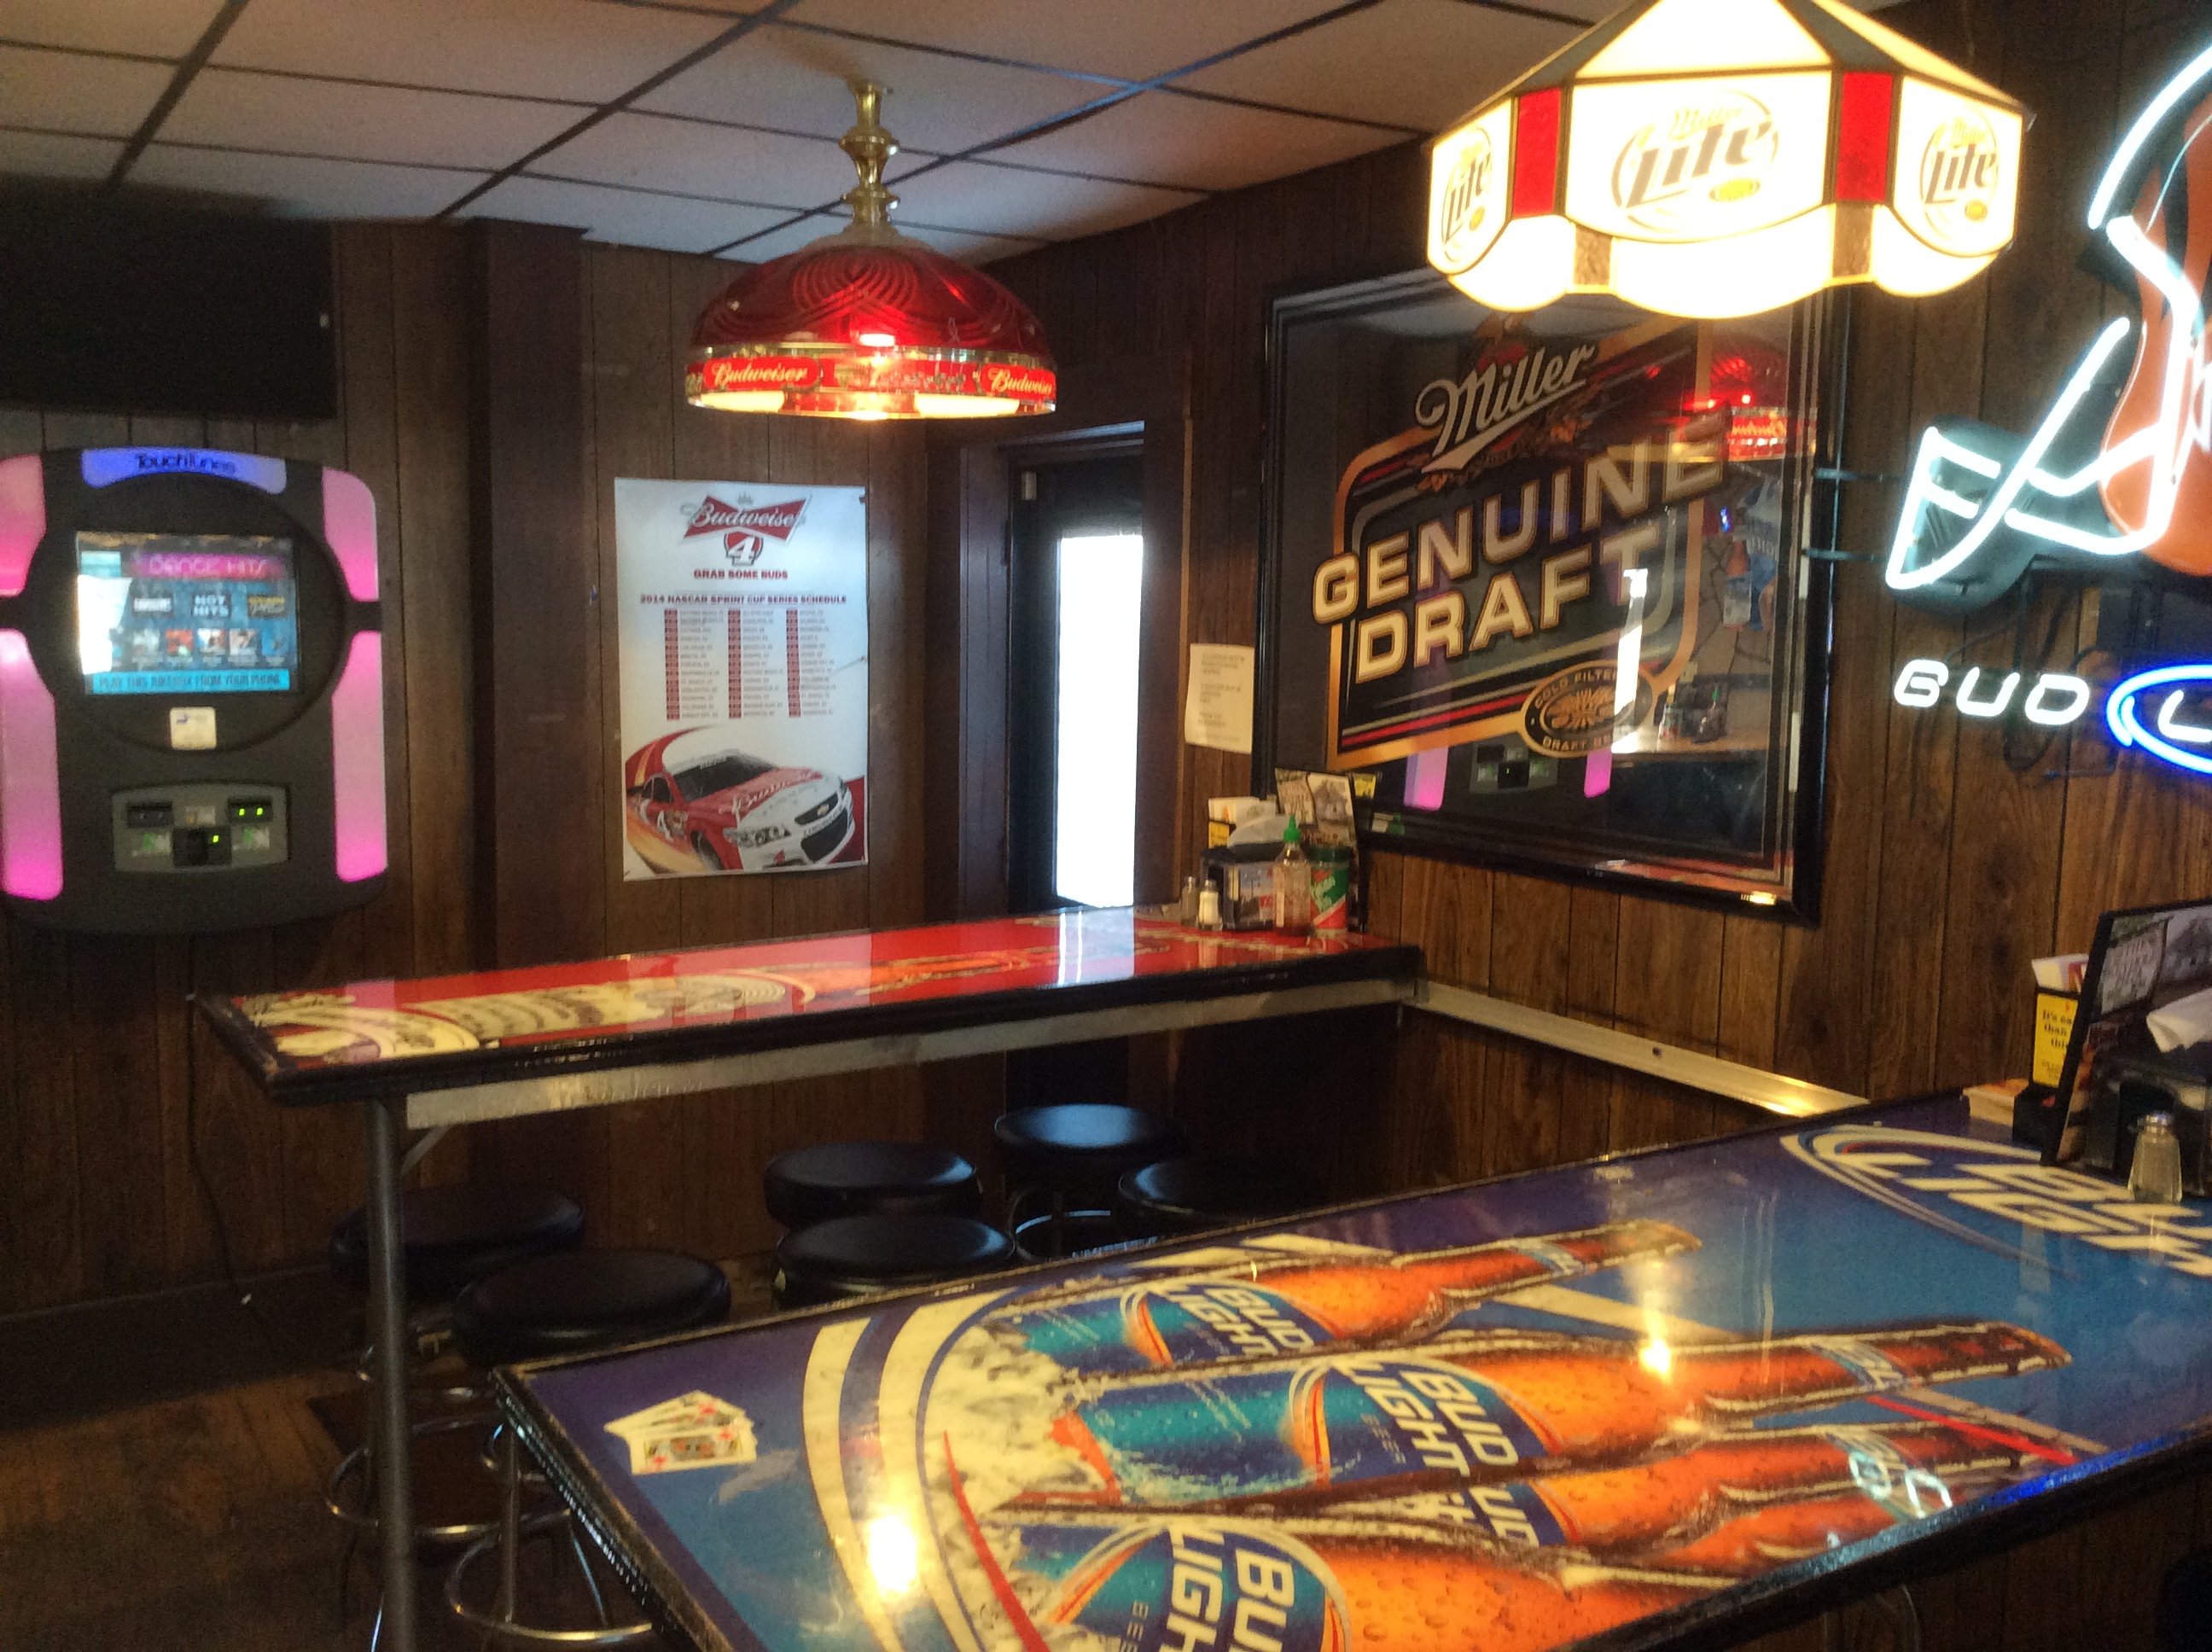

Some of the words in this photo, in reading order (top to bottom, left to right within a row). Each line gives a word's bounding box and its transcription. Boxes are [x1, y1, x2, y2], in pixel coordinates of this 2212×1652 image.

[1626, 120, 1772, 208] Lite
[1924, 143, 1997, 204] Lite
[1443, 151, 1492, 244] Lite
[711, 361, 808, 387] Budweiser
[1415, 343, 1594, 465] Miller
[680, 502, 806, 527] Budweiser
[1313, 422, 1724, 625] GENUINE
[694, 569, 725, 579] GRAB
[728, 570, 759, 579] SOME
[761, 570, 788, 579] BUDS
[726, 536, 760, 567] 4
[195, 595, 225, 604] HOT
[641, 594, 665, 603] 2014
[667, 595, 707, 603] NASCAR
[711, 595, 745, 603] SPRINT
[748, 595, 765, 603] CUP
[768, 595, 799, 604] SERIES
[800, 595, 847, 604] SCHEDULE
[1356, 522, 1660, 683] DRAFT
[1534, 678, 1569, 709] COLD
[1542, 736, 1588, 751] DRAFT
[1166, 1284, 1278, 1357] LIGHT
[1204, 1288, 1315, 1351] BUD
[1333, 1362, 1471, 1477] LIGHT
[1400, 1370, 1519, 1466] BUD
